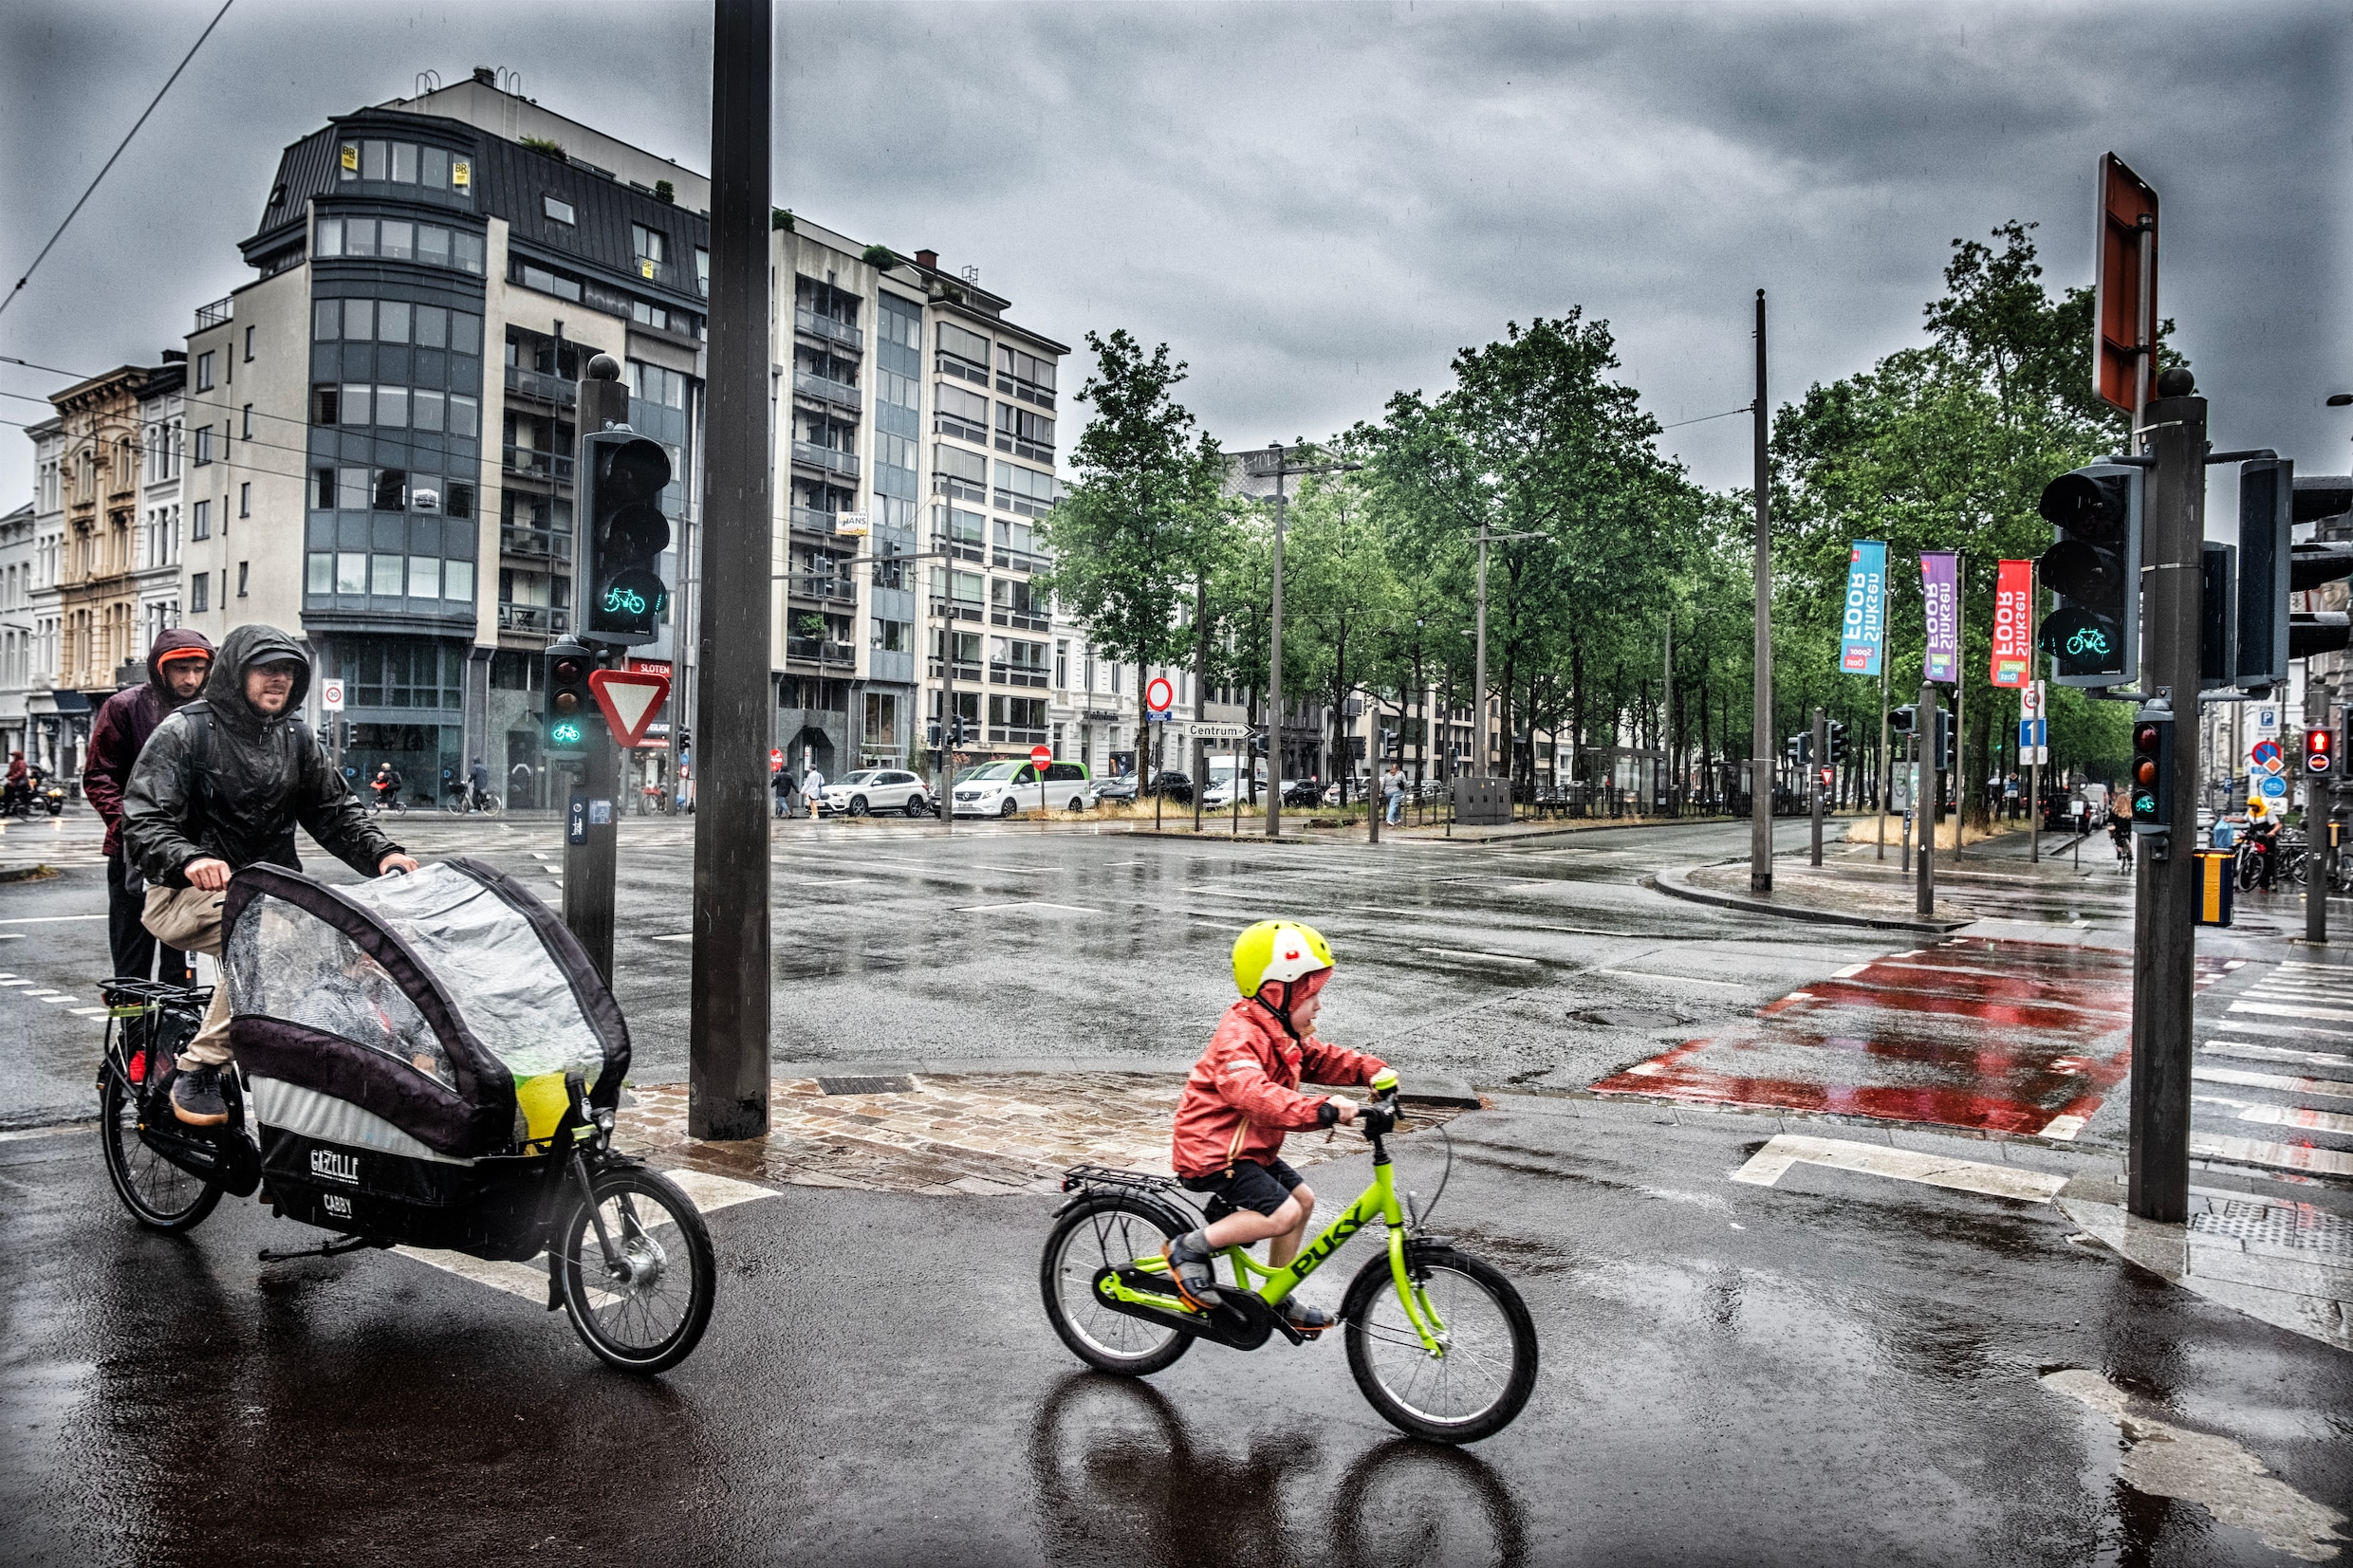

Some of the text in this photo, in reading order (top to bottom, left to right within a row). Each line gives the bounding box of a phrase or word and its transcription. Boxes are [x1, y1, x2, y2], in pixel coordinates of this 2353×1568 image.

[640, 663, 670, 674] SLOTEN
[1190, 725, 1237, 736] Centrum
[310, 1150, 359, 1180] GAZELLE
[324, 1193, 352, 1215] CABBY
[1290, 1203, 1364, 1279] PUKY
